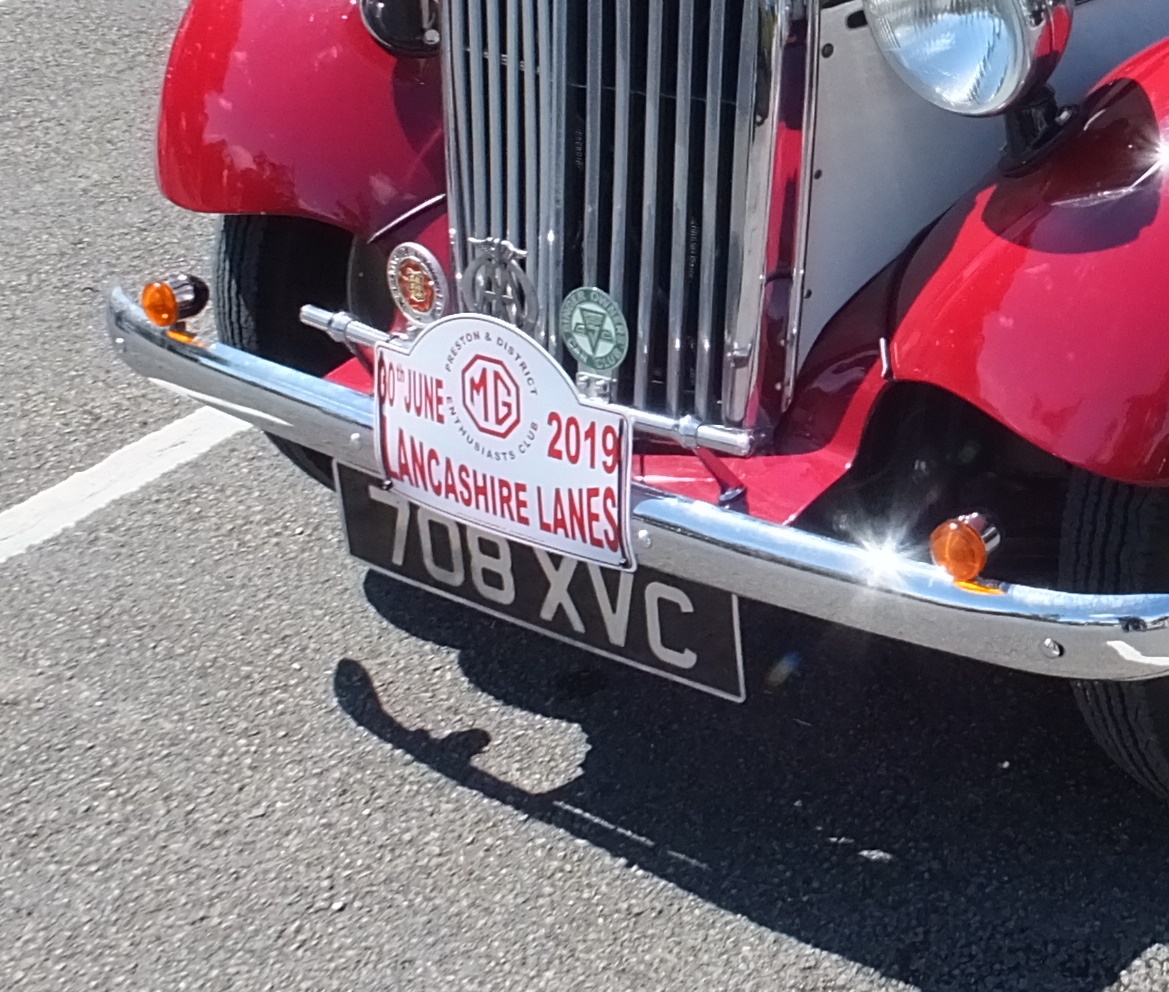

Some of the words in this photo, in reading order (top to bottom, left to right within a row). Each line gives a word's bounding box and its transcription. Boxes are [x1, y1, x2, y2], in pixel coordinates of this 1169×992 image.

[404, 368, 445, 424] JUNE
[445, 331, 481, 372] PRESTON
[484, 331, 492, 342] &
[496, 336, 538, 396] DISTRICT
[469, 366, 512, 426] MG
[445, 396, 516, 461] ENTHUSIASTS
[518, 421, 539, 455] CLUB
[546, 411, 620, 474] 2019
[381, 414, 530, 526] LANCASHIRE
[536, 485, 621, 553] LANES
[368, 485, 516, 606] 708
[533, 546, 698, 670] XVC
